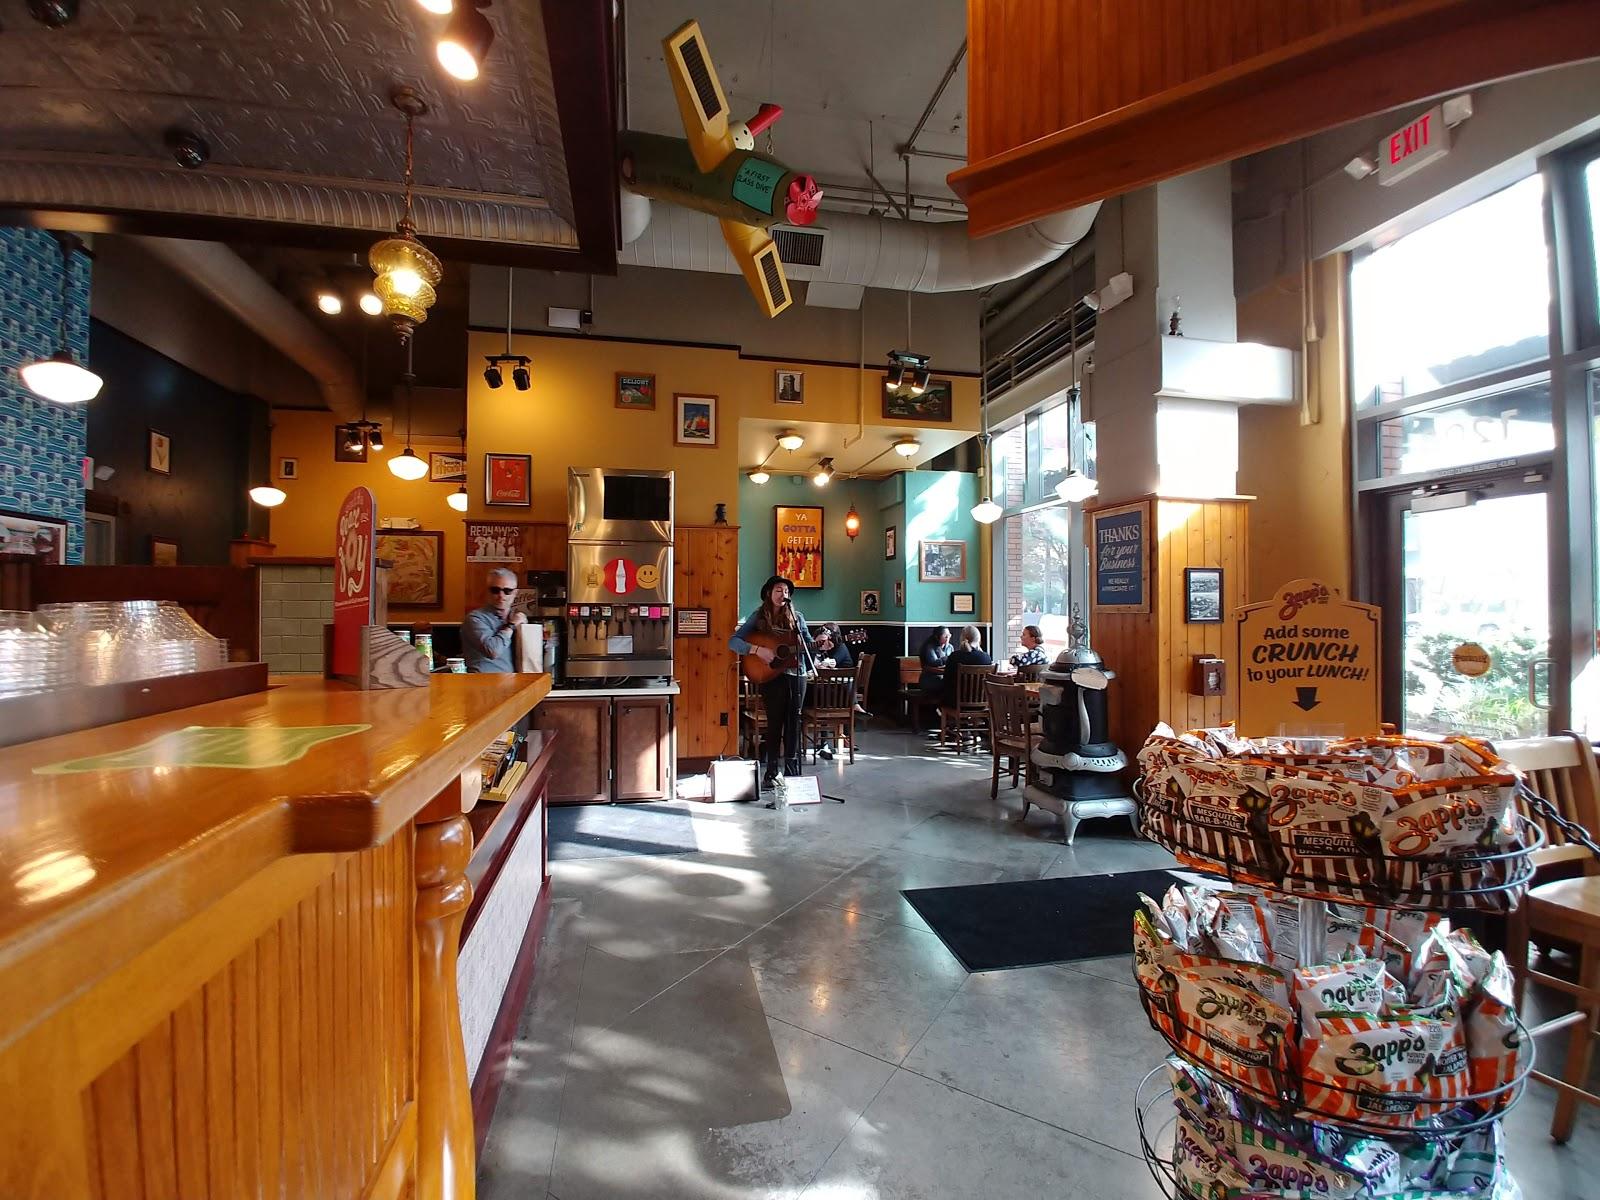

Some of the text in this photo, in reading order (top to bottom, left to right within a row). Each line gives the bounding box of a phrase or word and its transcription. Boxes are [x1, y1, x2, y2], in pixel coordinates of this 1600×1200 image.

[1390, 115, 1431, 164] EXIT
[795, 513, 808, 521] YA
[783, 525, 816, 533] GOTTA
[1099, 525, 1140, 544] THANKS
[787, 535, 814, 545] GET IT
[1101, 544, 1138, 560] for your
[1099, 557, 1136, 571] Business
[1264, 625, 1350, 640] Add some
[1252, 642, 1359, 664] CRUNCH
[1247, 665, 1369, 683] to your LUNCH!
[1267, 783, 1357, 827] Zapp's
[1194, 814, 1242, 829] BAR-B-QUE
[1196, 806, 1238, 821] MESQUITE
[1388, 794, 1483, 856] Zapp's
[1303, 836, 1356, 847] MESQUITE
[1335, 1029, 1426, 1076] Zapp's
[1248, 1153, 1329, 1195] Zapp's
